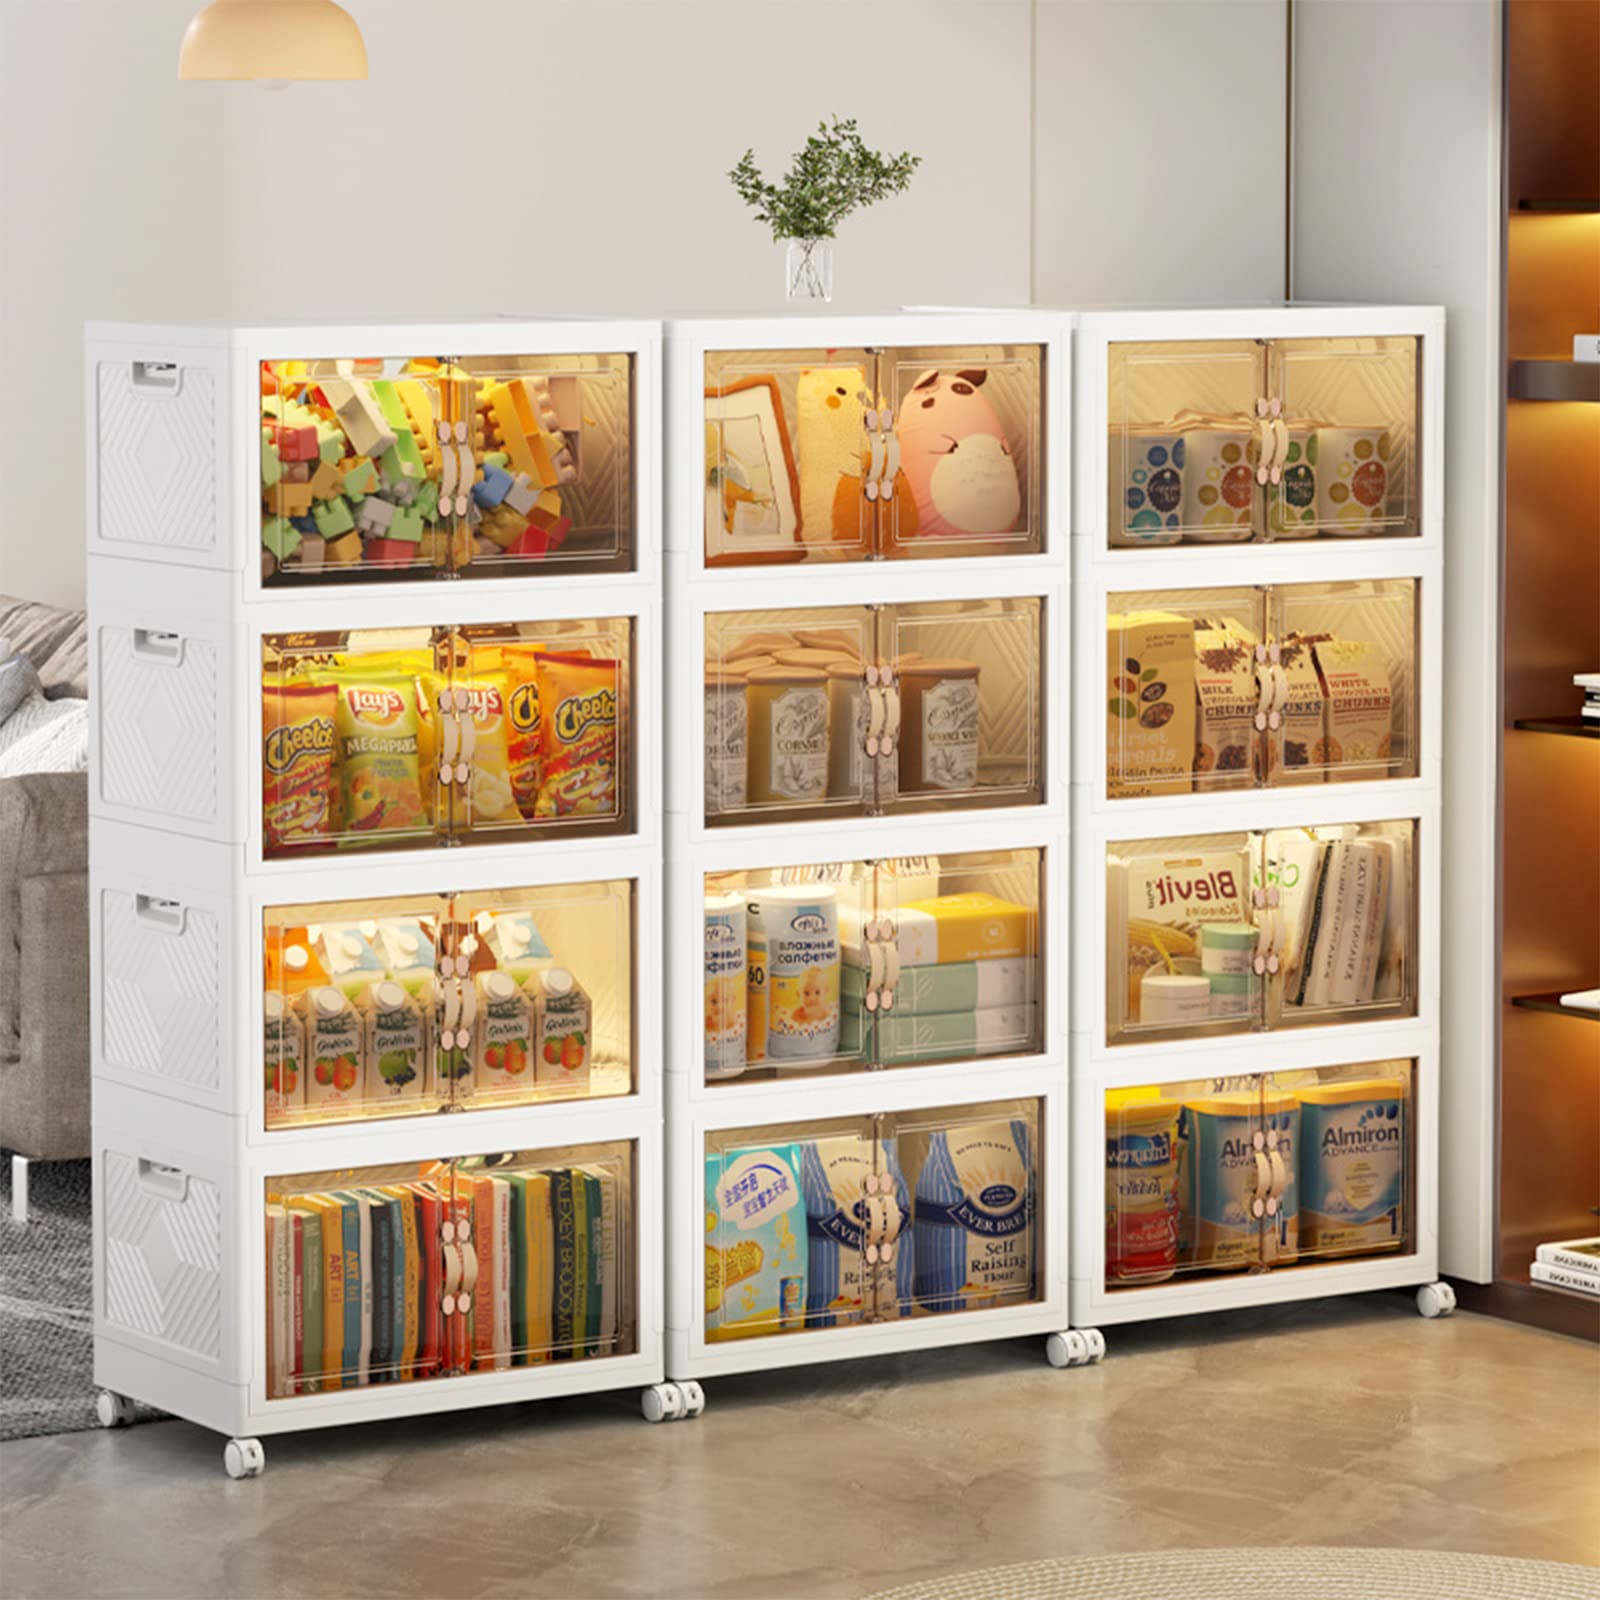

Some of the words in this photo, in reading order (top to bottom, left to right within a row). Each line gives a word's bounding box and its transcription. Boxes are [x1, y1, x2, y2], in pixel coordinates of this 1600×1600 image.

[1202, 685, 1233, 695] MILK
[1330, 679, 1369, 689] WHITE
[1205, 705, 1255, 718] CHUN
[1283, 700, 1322, 712] UNKS
[1332, 695, 1391, 709] CHUNKS
[557, 692, 616, 741] Cheeto
[1322, 1125, 1399, 1148] Almirón
[1322, 1143, 1379, 1158] ADVANCE
[959, 1205, 993, 1233] EVER
[1386, 1207, 1397, 1236] 1
[984, 1238, 1017, 1257] Self
[329, 1253, 342, 1282] ART
[345, 1249, 360, 1281] ART
